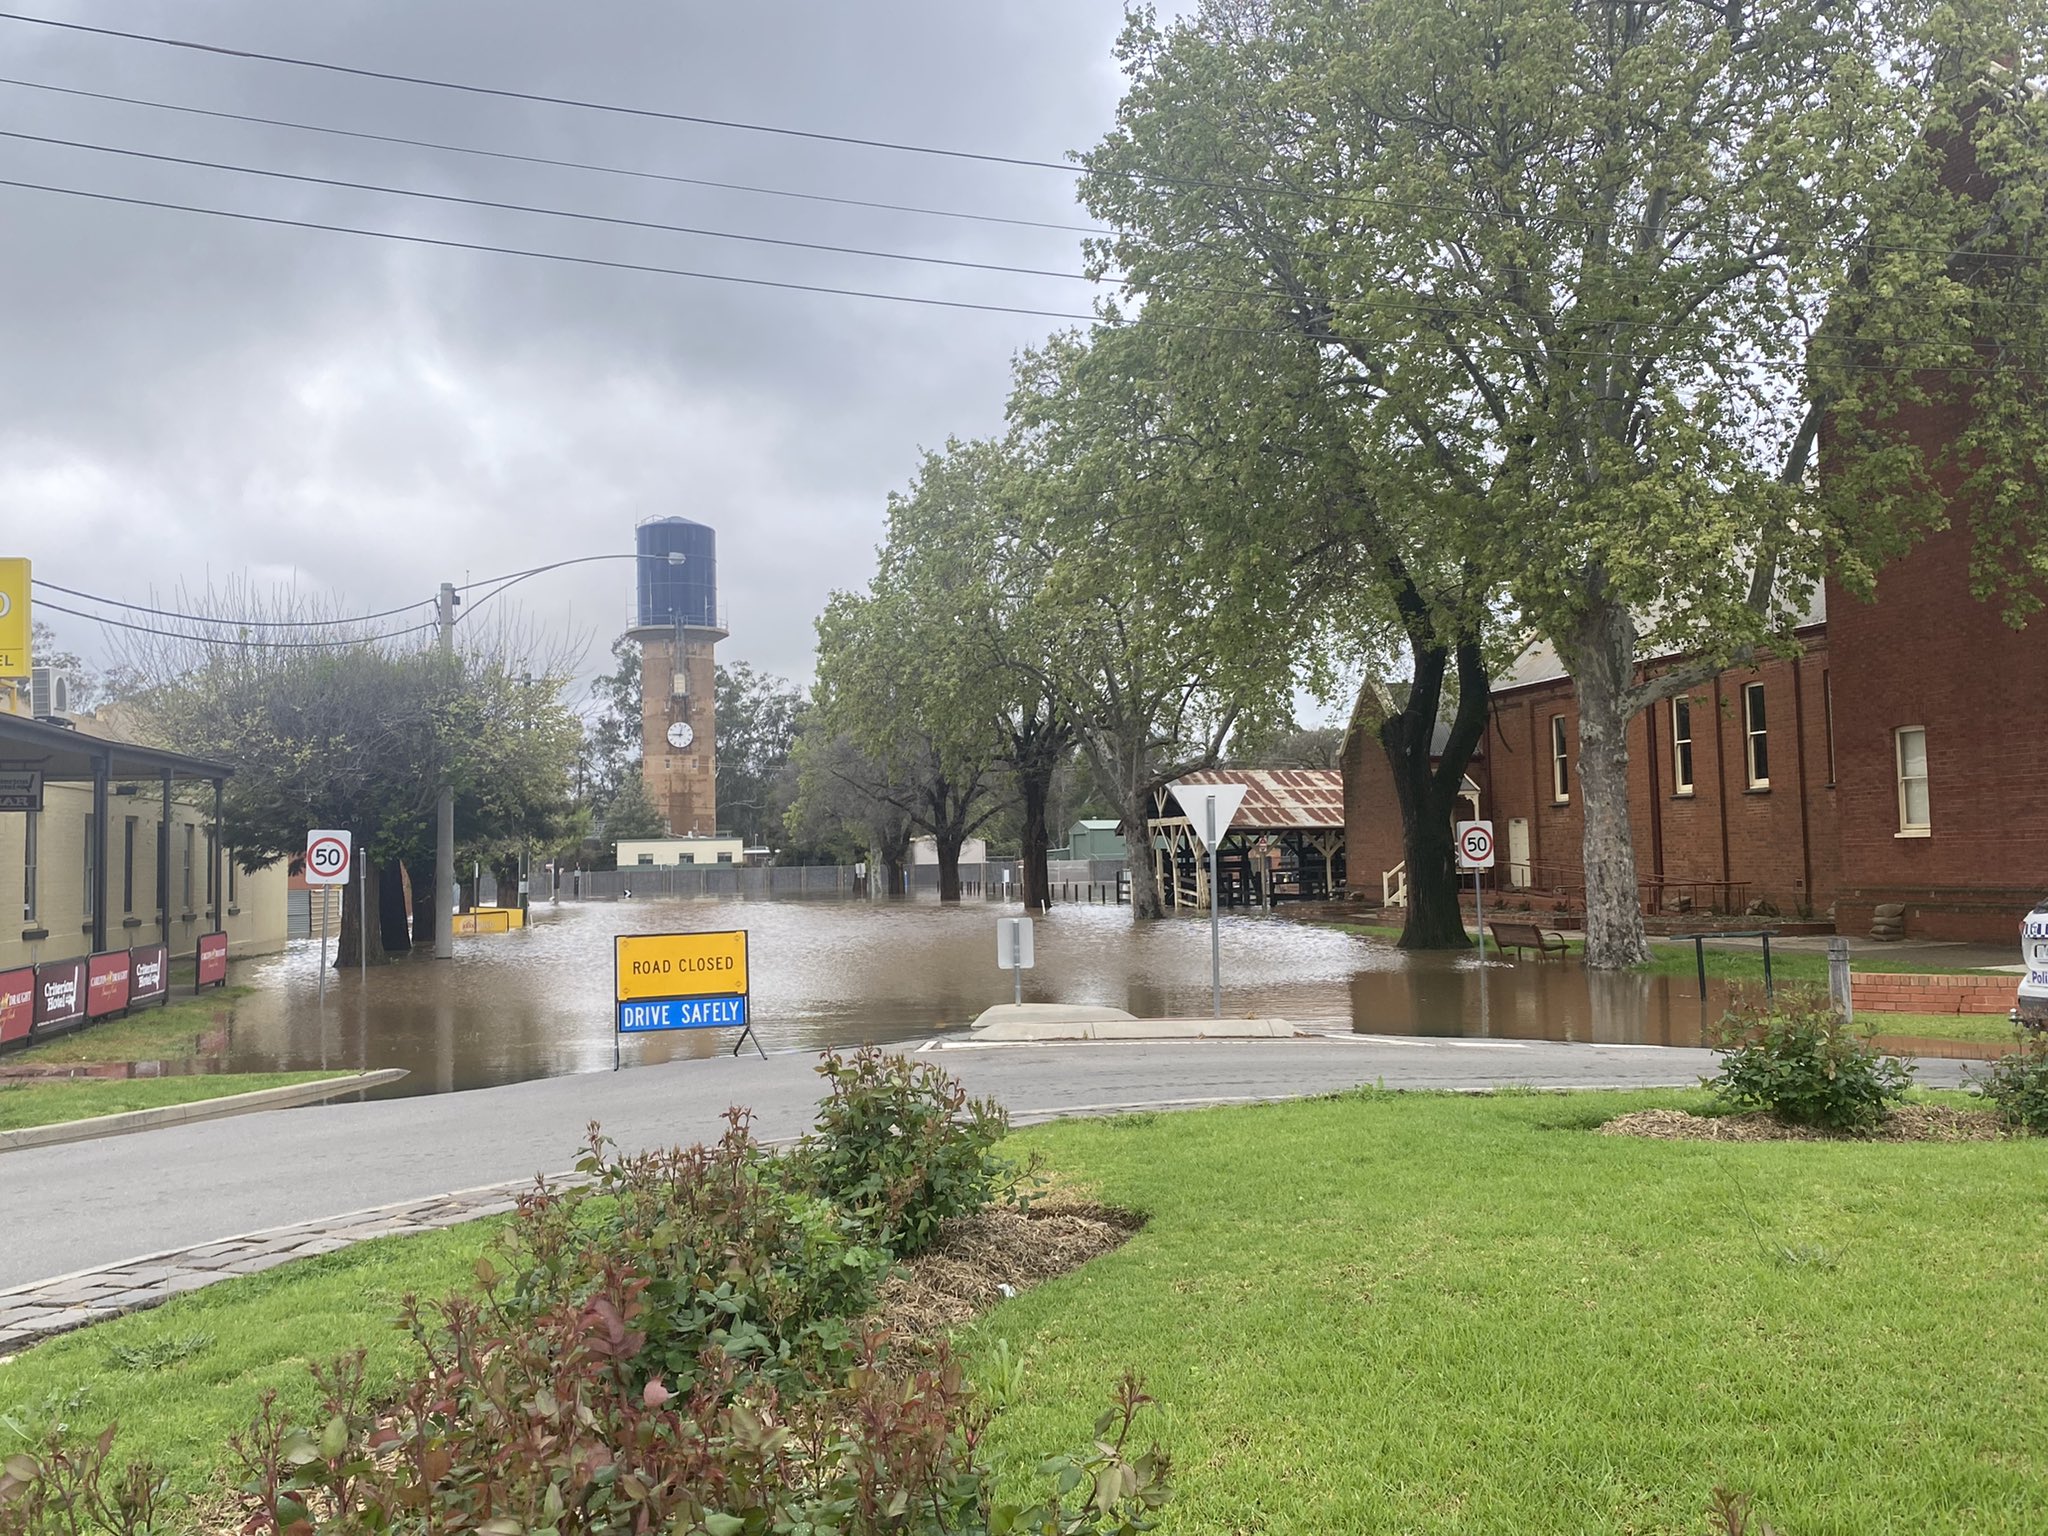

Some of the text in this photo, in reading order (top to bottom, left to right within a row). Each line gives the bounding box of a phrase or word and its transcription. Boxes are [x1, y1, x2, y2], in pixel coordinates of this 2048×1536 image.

[0, 797, 28, 806] AR
[1467, 837, 1487, 852] 50
[315, 849, 340, 866] 50
[633, 956, 734, 975] ROAD CLOSED
[44, 980, 74, 997] Criterion
[47, 994, 65, 1011] Hotel
[625, 1001, 739, 1027] DRIVE SAFELY
